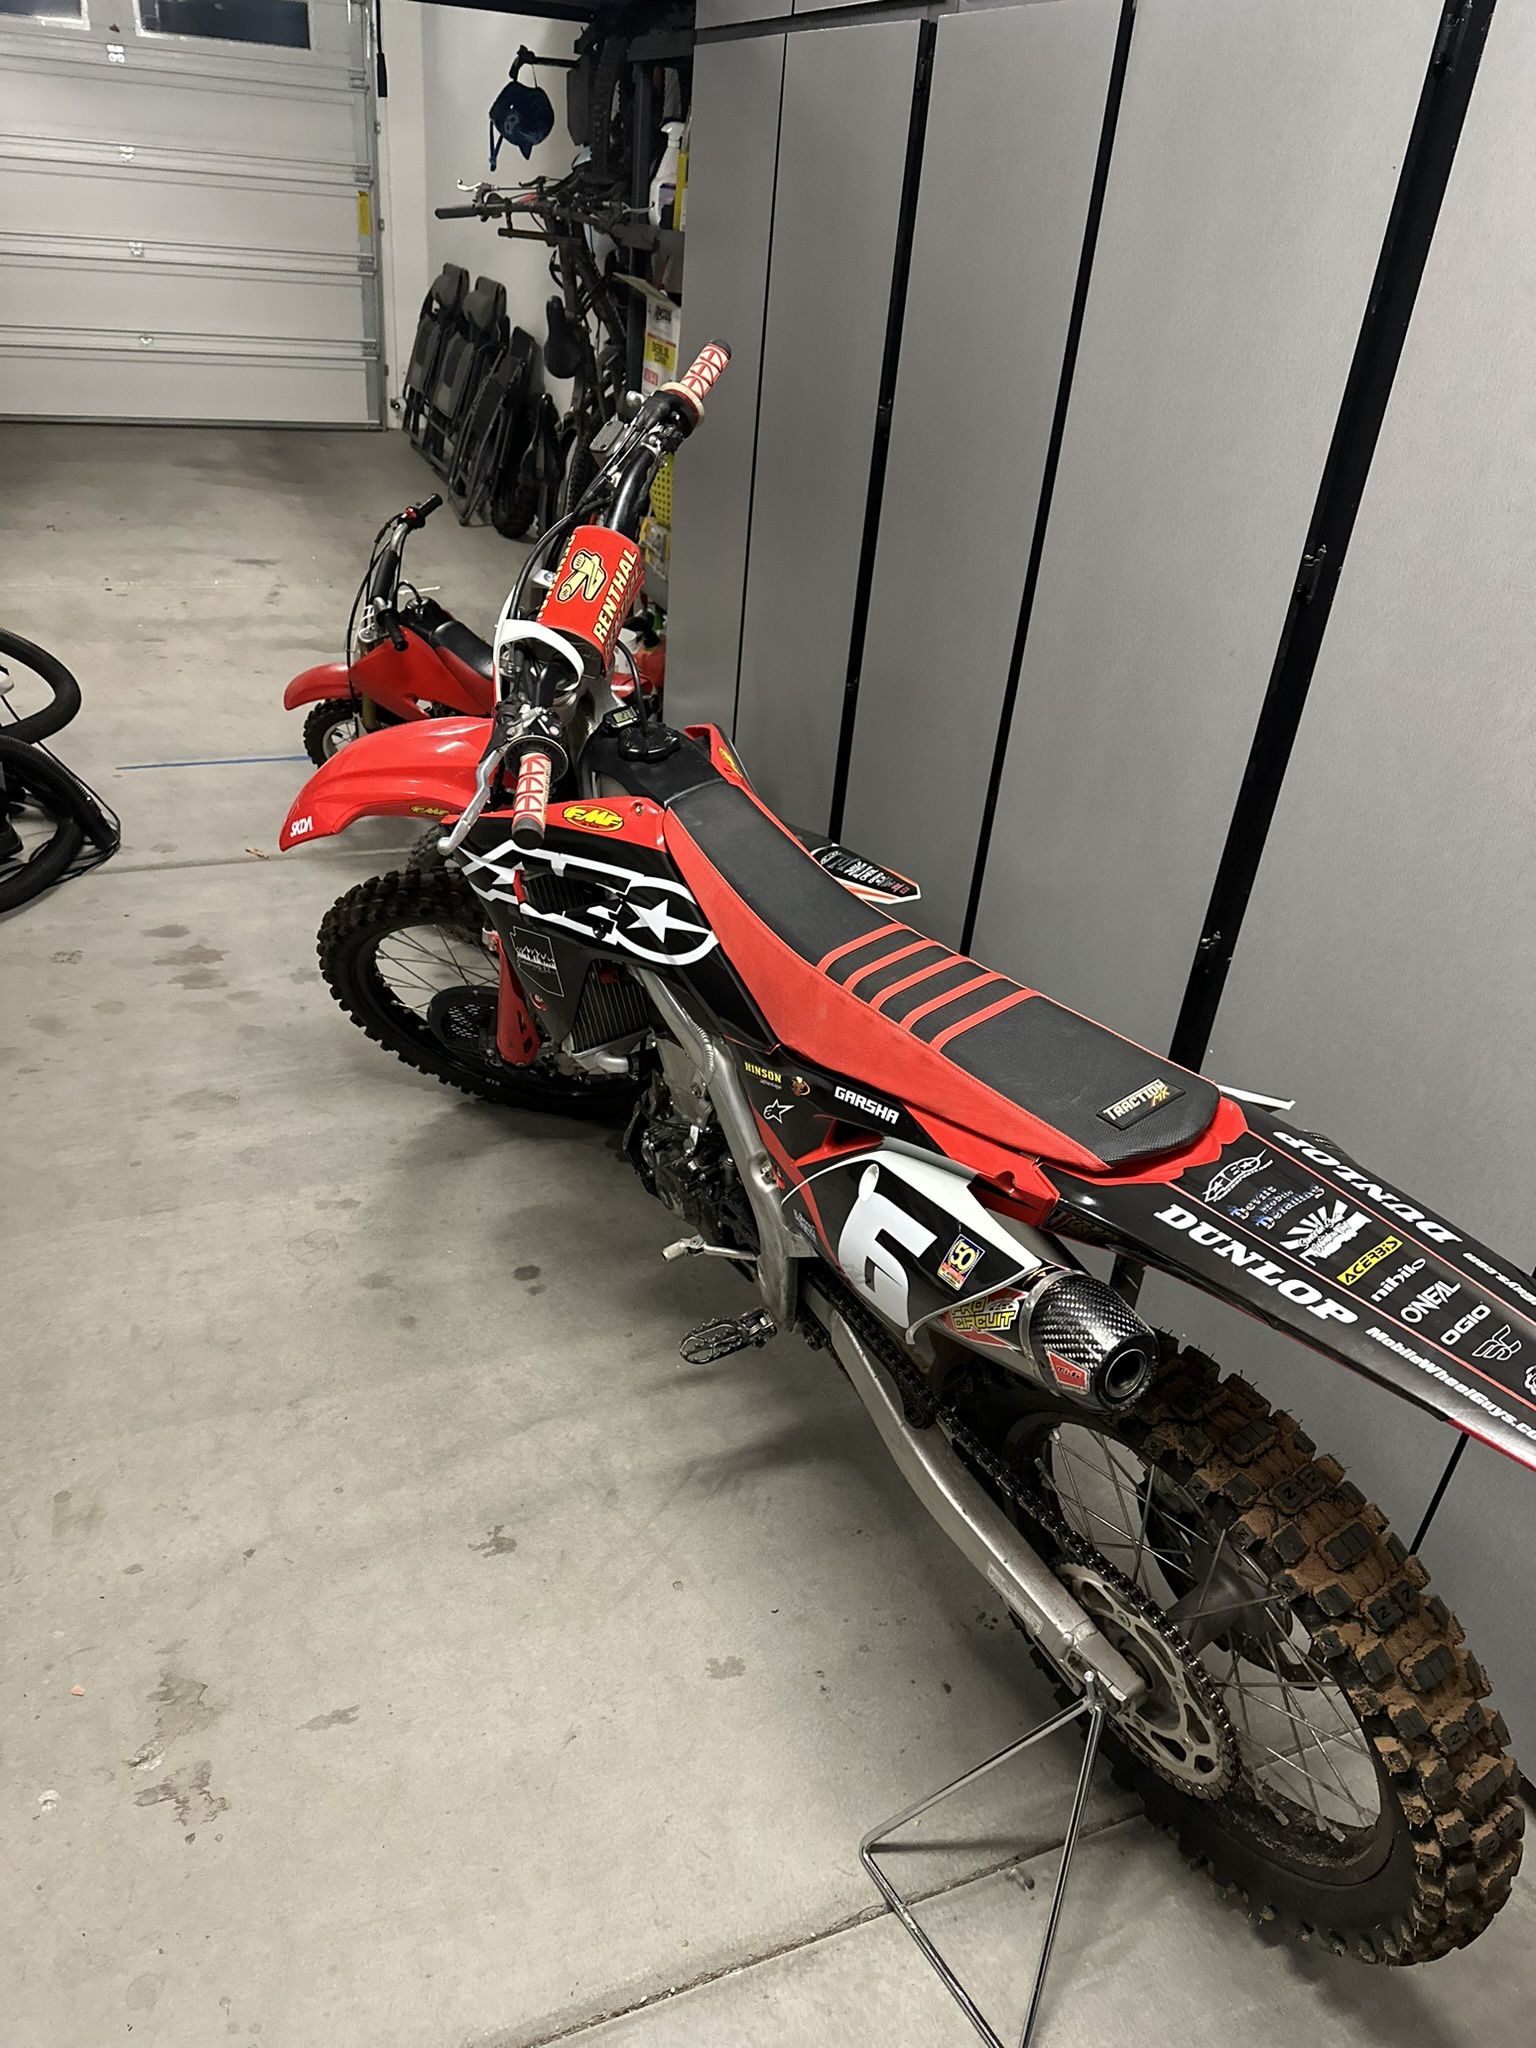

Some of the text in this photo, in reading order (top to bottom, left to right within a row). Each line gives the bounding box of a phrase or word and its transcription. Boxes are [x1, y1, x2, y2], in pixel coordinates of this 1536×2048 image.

[592, 548, 638, 644] RENTHAL
[563, 806, 625, 829] FMF
[744, 1062, 782, 1084] HINSON
[834, 1086, 900, 1125] GARSHA
[1102, 1078, 1167, 1121] TRACTION
[1273, 1131, 1463, 1244] DUNLOP
[949, 1241, 978, 1272] 50
[1153, 1203, 1359, 1325] DUNLOP
[1370, 1257, 1427, 1302] nihilo
[951, 1297, 989, 1315] PRO
[952, 1310, 1016, 1331] CIRCUIT
[1440, 1304, 1492, 1346] OGIO
